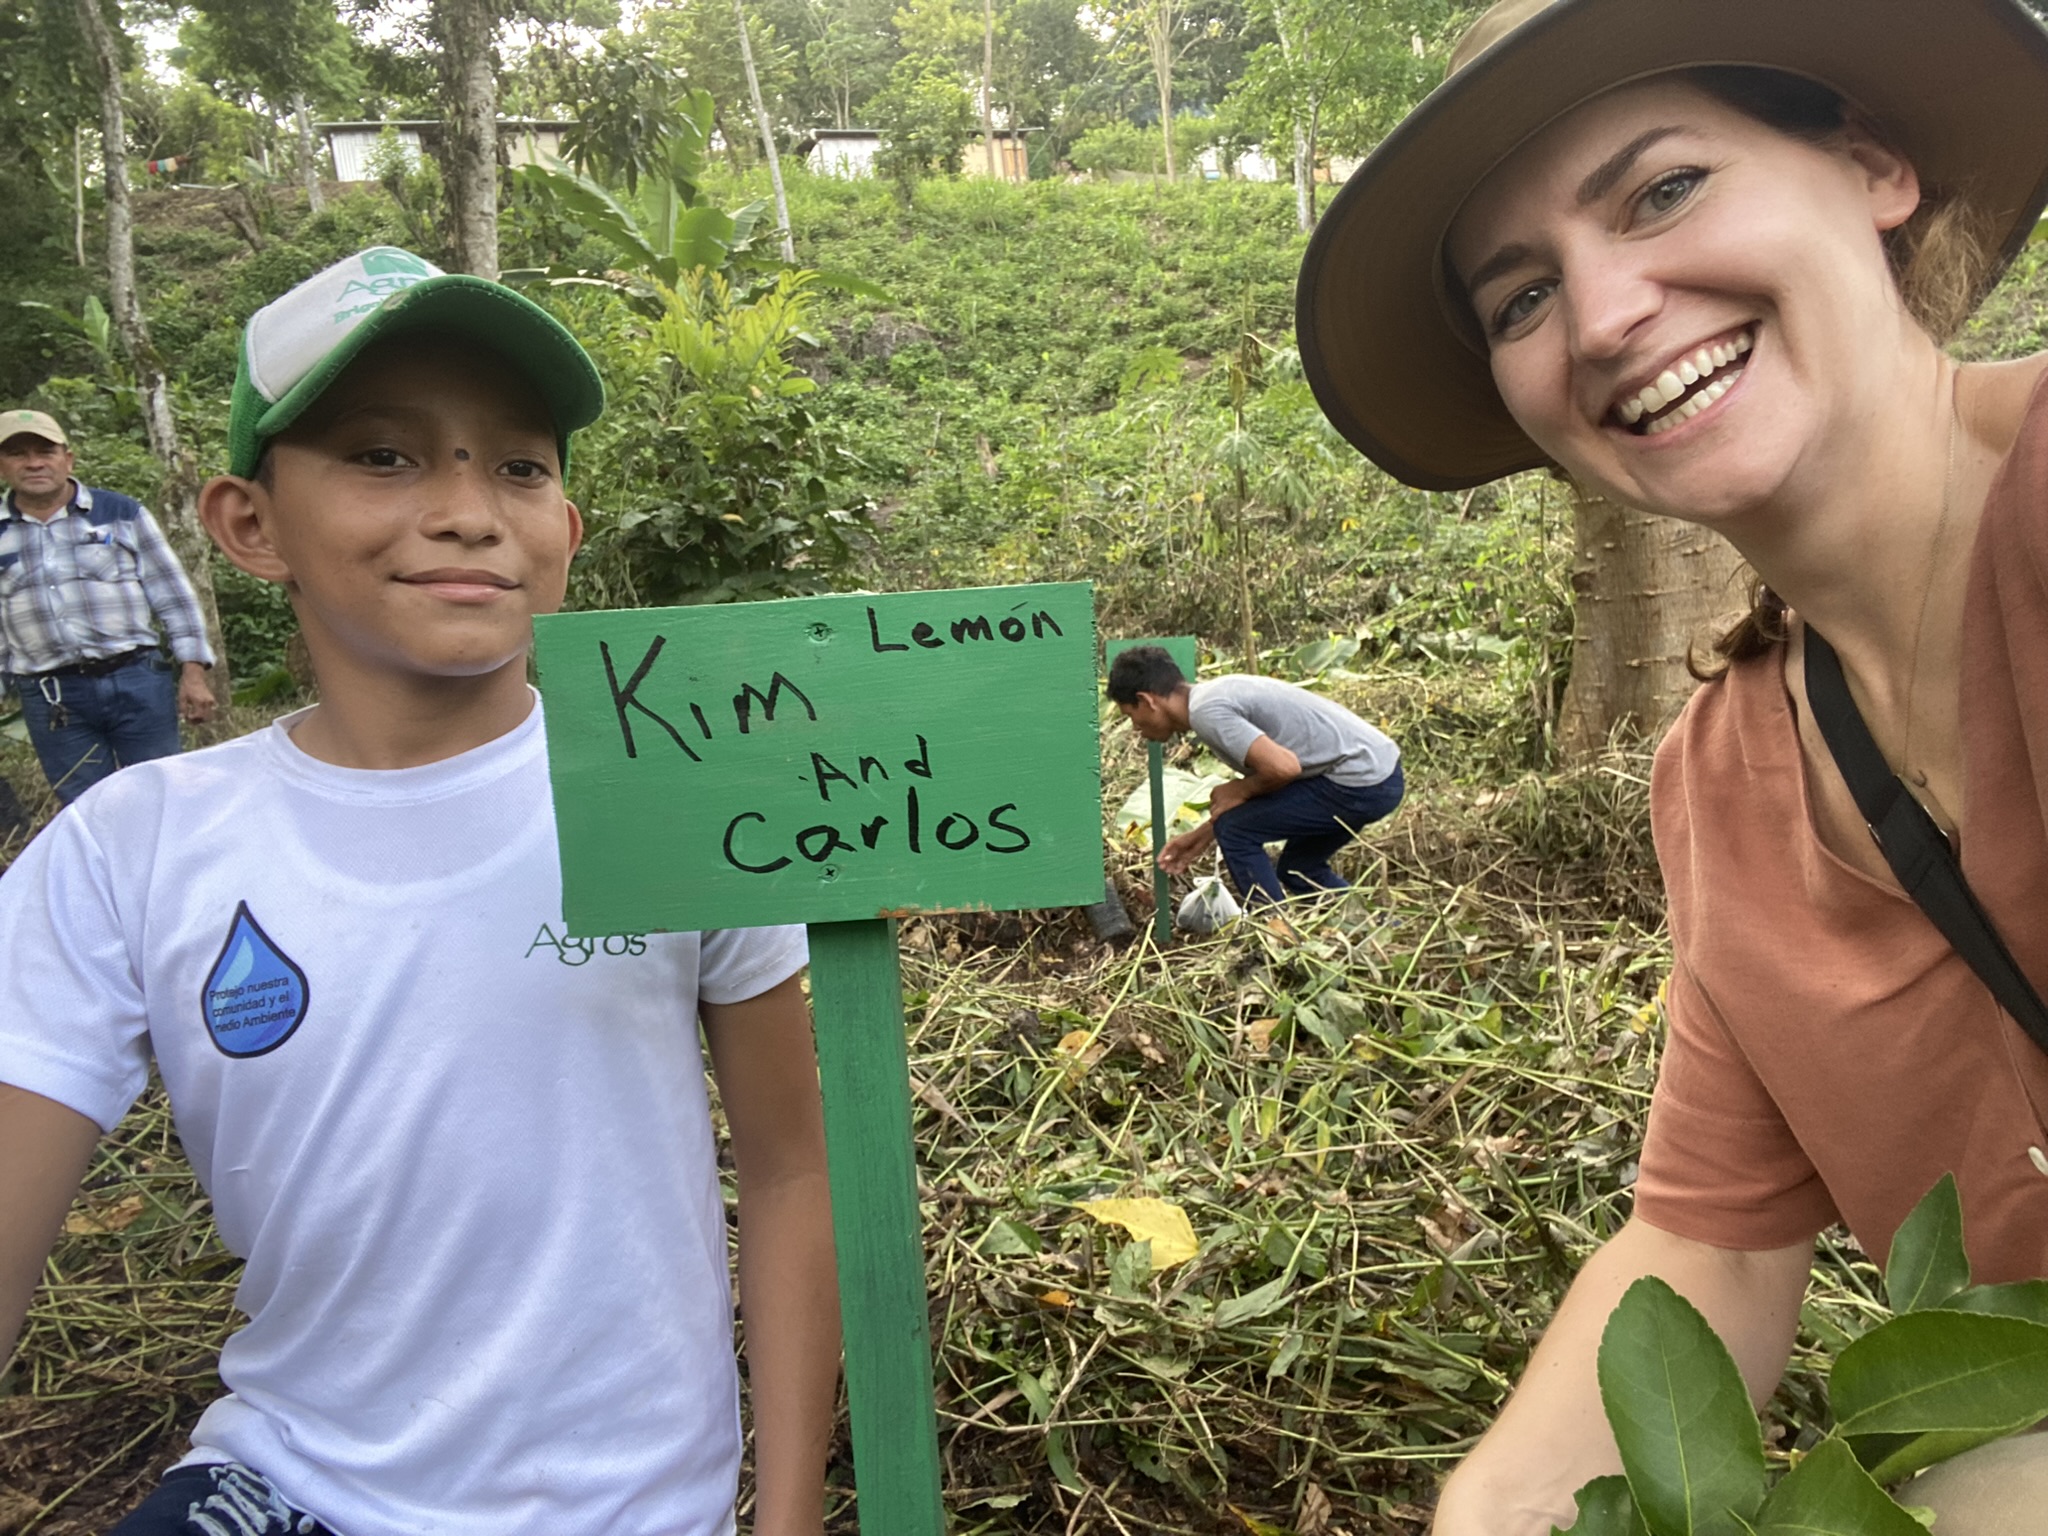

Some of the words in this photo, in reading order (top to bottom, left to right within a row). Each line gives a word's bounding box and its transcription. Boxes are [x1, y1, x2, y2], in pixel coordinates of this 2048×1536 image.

[336, 277, 420, 303] Agr
[868, 602, 1063, 653] Lemón
[811, 735, 933, 802] And
[722, 786, 1031, 874] Carlos
[209, 985, 244, 1002] Protejo
[247, 977, 289, 993] nuestra
[212, 996, 265, 1018] comunidad
[268, 996, 276, 1008] y
[278, 991, 290, 1003] el
[214, 1019, 241, 1033] medio
[242, 1008, 296, 1028] Ambiente
